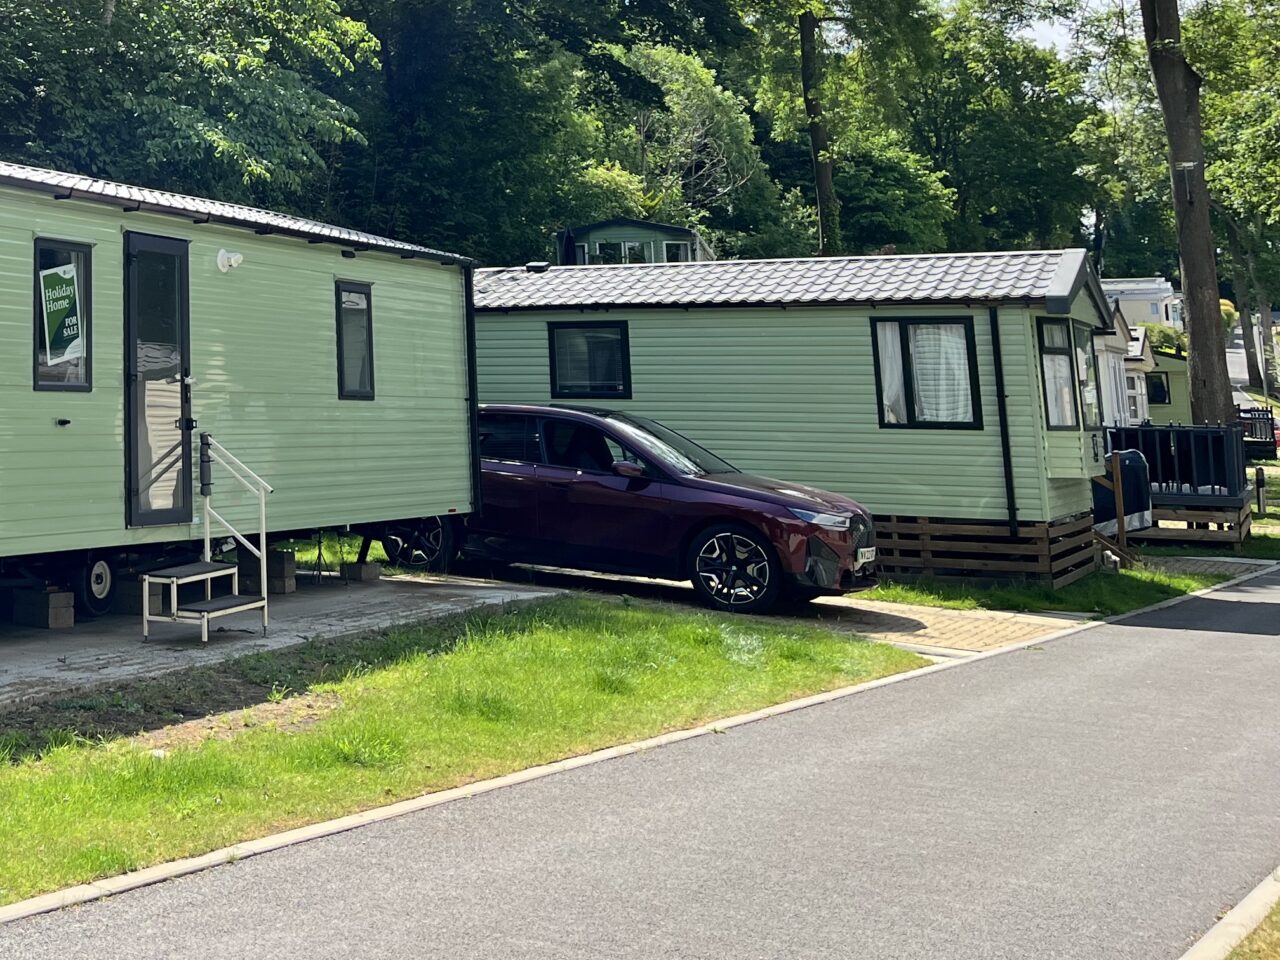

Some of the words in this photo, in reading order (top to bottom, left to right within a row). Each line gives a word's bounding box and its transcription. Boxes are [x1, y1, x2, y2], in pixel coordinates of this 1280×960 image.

[45, 284, 74, 300] Holiday
[47, 298, 69, 312] Home
[65, 316, 77, 326] FOR
[63, 326, 78, 336] SALE
